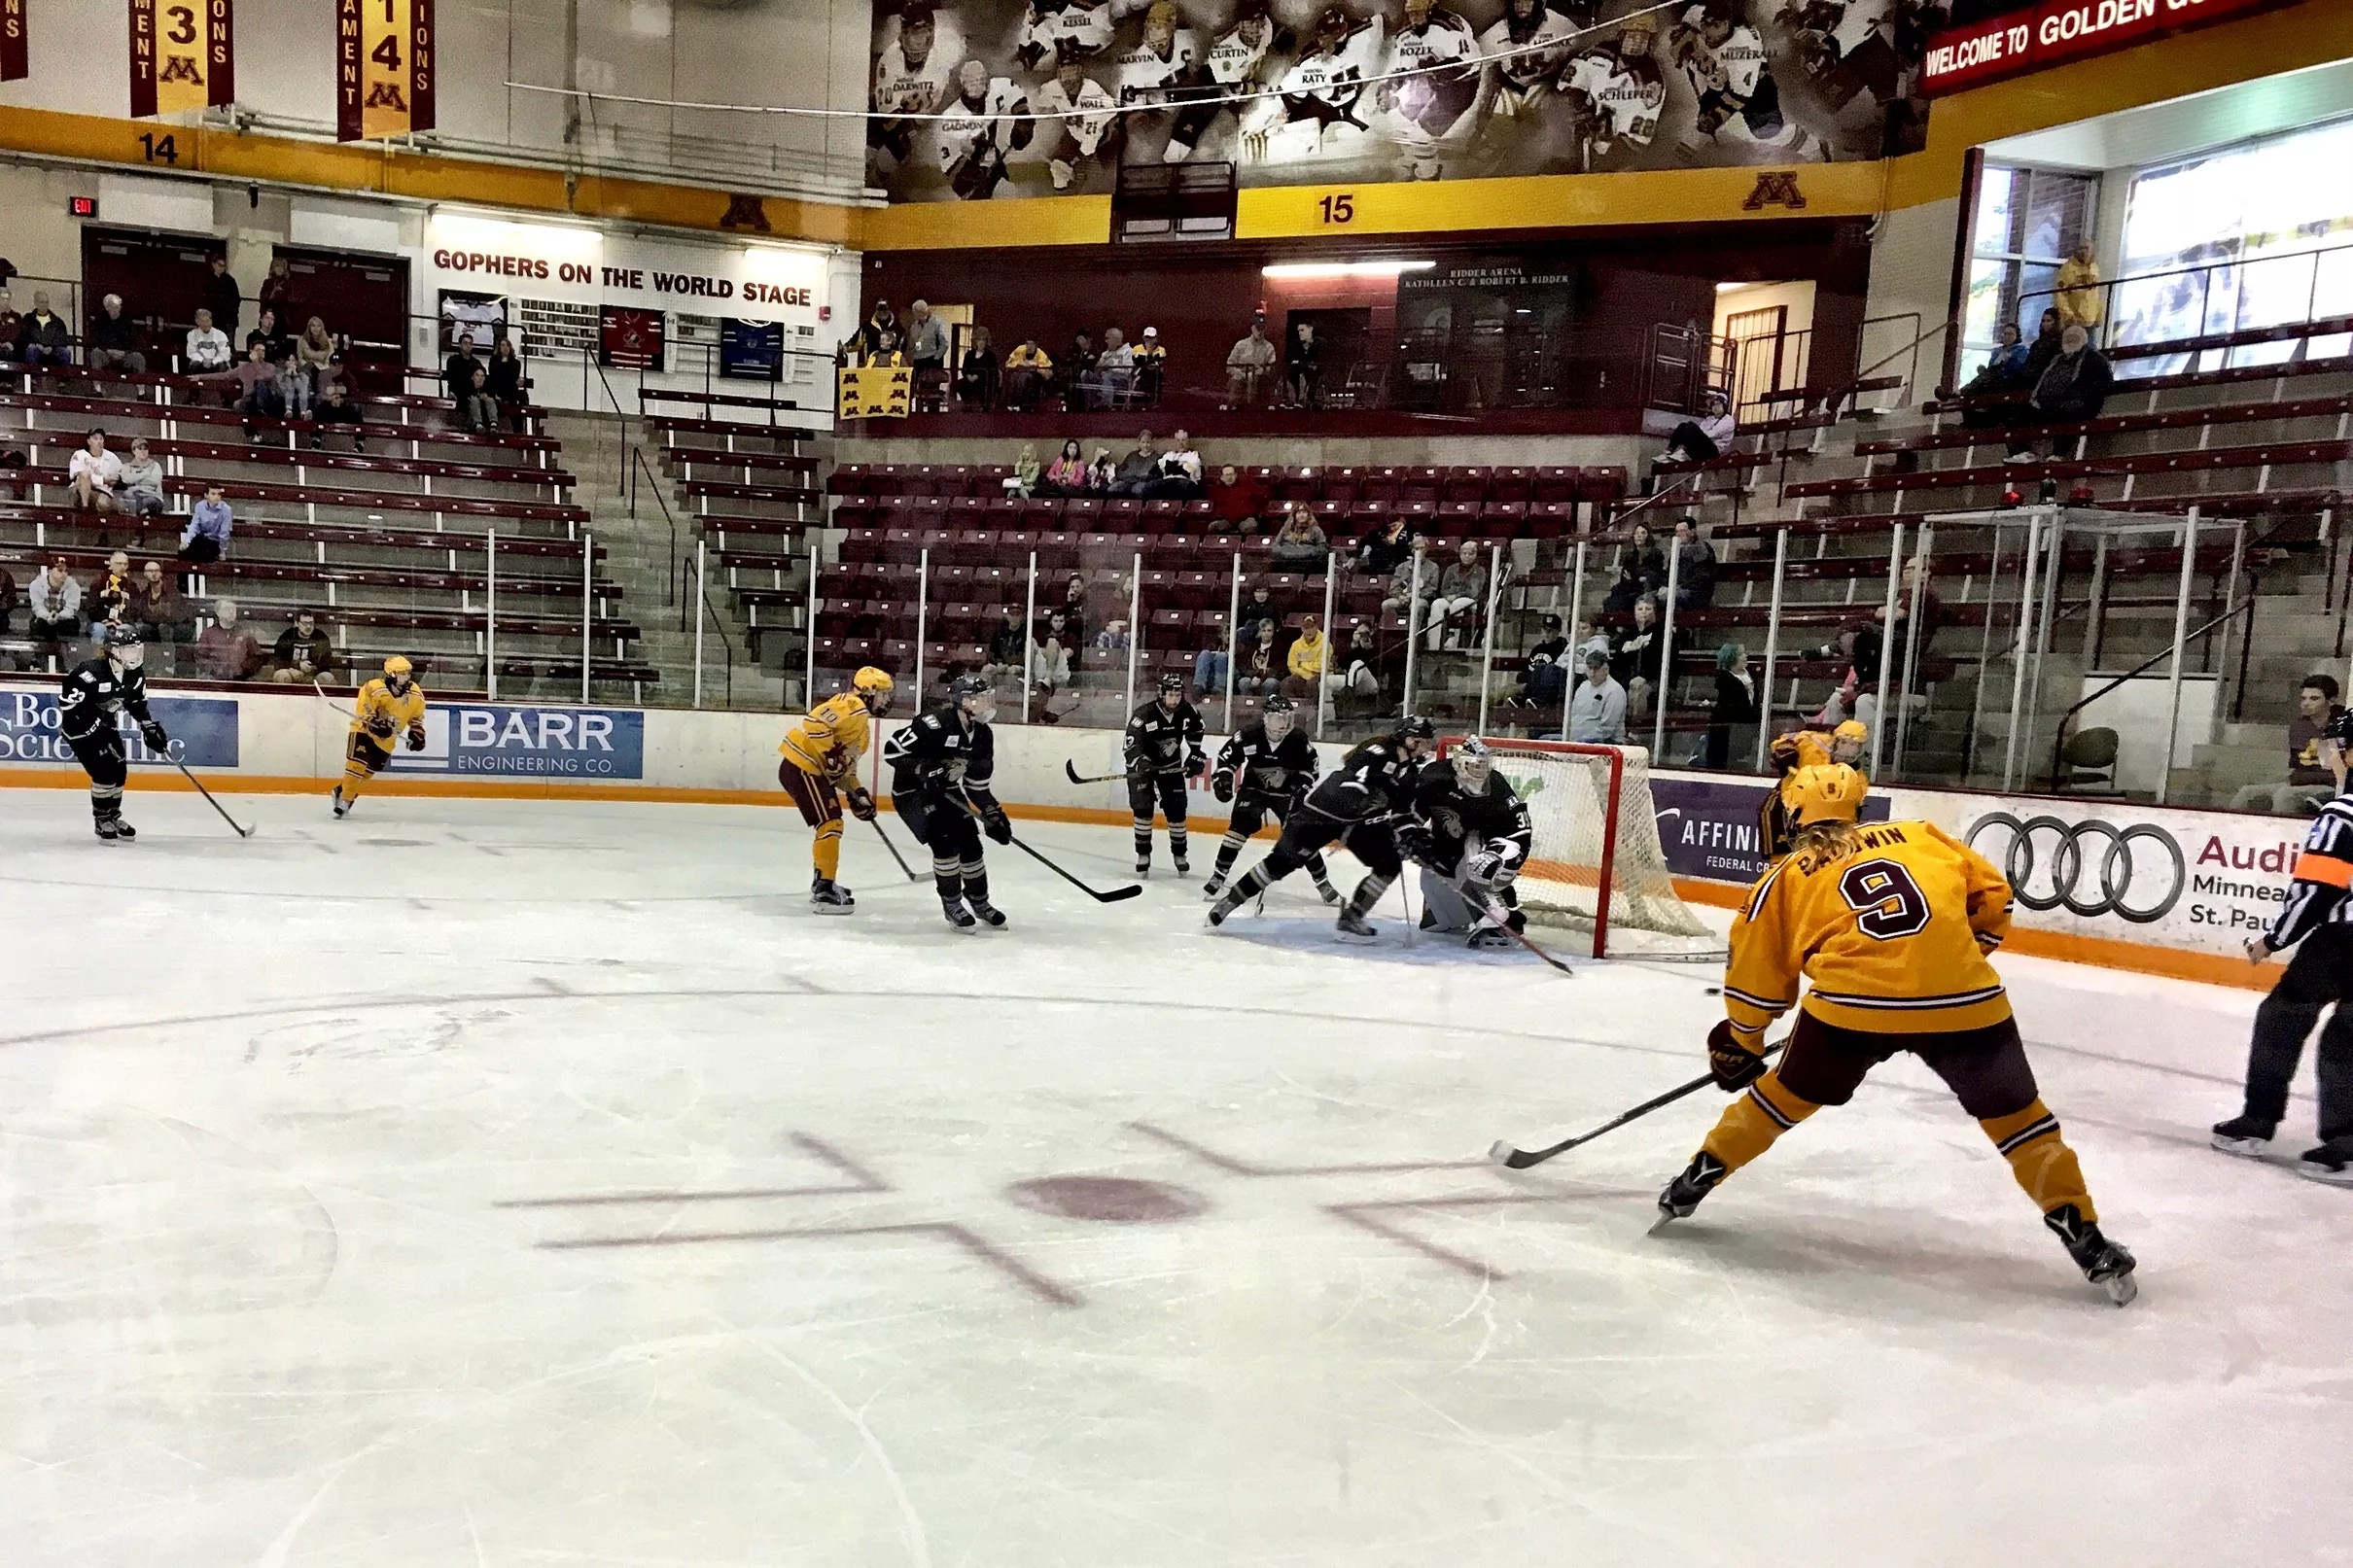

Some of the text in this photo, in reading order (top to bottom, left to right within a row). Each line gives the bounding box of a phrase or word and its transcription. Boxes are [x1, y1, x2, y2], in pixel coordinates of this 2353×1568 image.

[1926, 0, 2156, 77] WELCOME TO GOLDEN
[1209, 48, 1249, 59] CURTIN
[893, 81, 933, 92] DARWITZ
[1301, 74, 1327, 85] RATY
[139, 132, 178, 163] 14
[1318, 193, 1353, 224] 15
[434, 250, 811, 307] GOPHERS ON THE WORLD STAGE
[1450, 269, 1487, 278] RIDDER
[458, 710, 615, 751] BARR
[897, 727, 919, 748] 17
[457, 754, 616, 774] ENGINEERING CO.
[1706, 855, 1752, 872] FEDERAL
[2196, 835, 2300, 874] Audi
[1839, 857, 1932, 941] 9
[2190, 904, 2223, 926] St.
